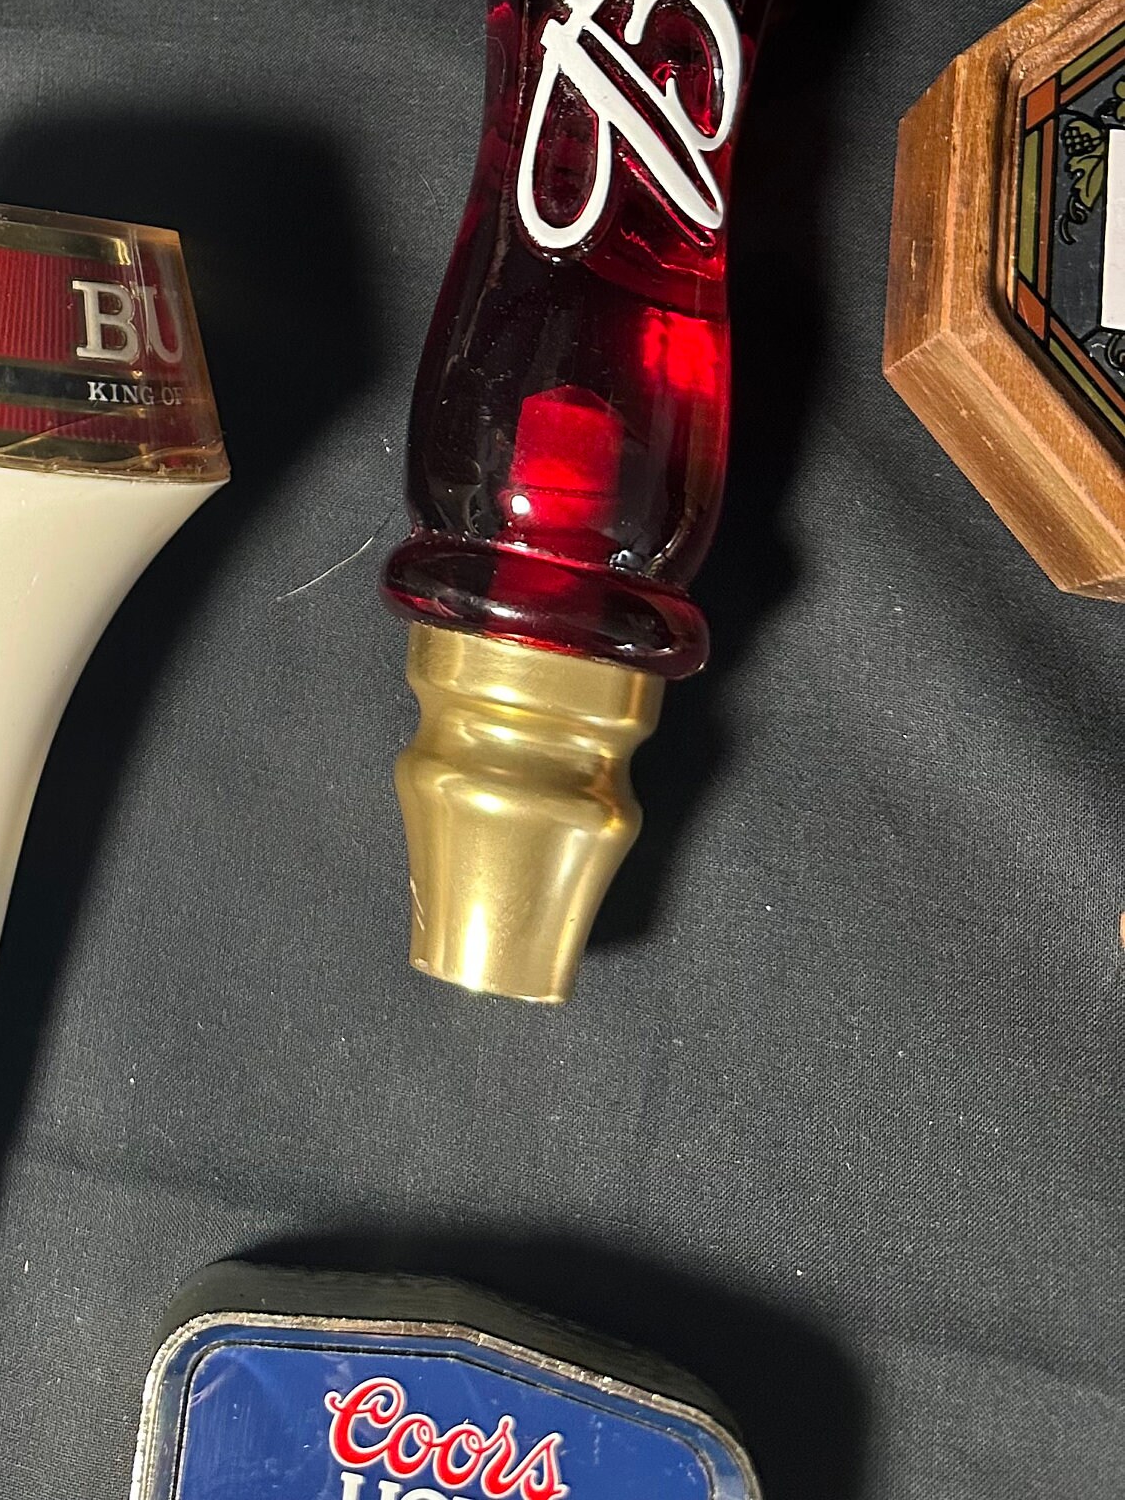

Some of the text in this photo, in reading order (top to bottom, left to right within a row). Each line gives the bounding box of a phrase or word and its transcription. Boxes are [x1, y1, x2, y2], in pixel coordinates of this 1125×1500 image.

[72, 279, 184, 364] BU
[87, 380, 155, 405] KING
[324, 1377, 570, 1500] Coors
